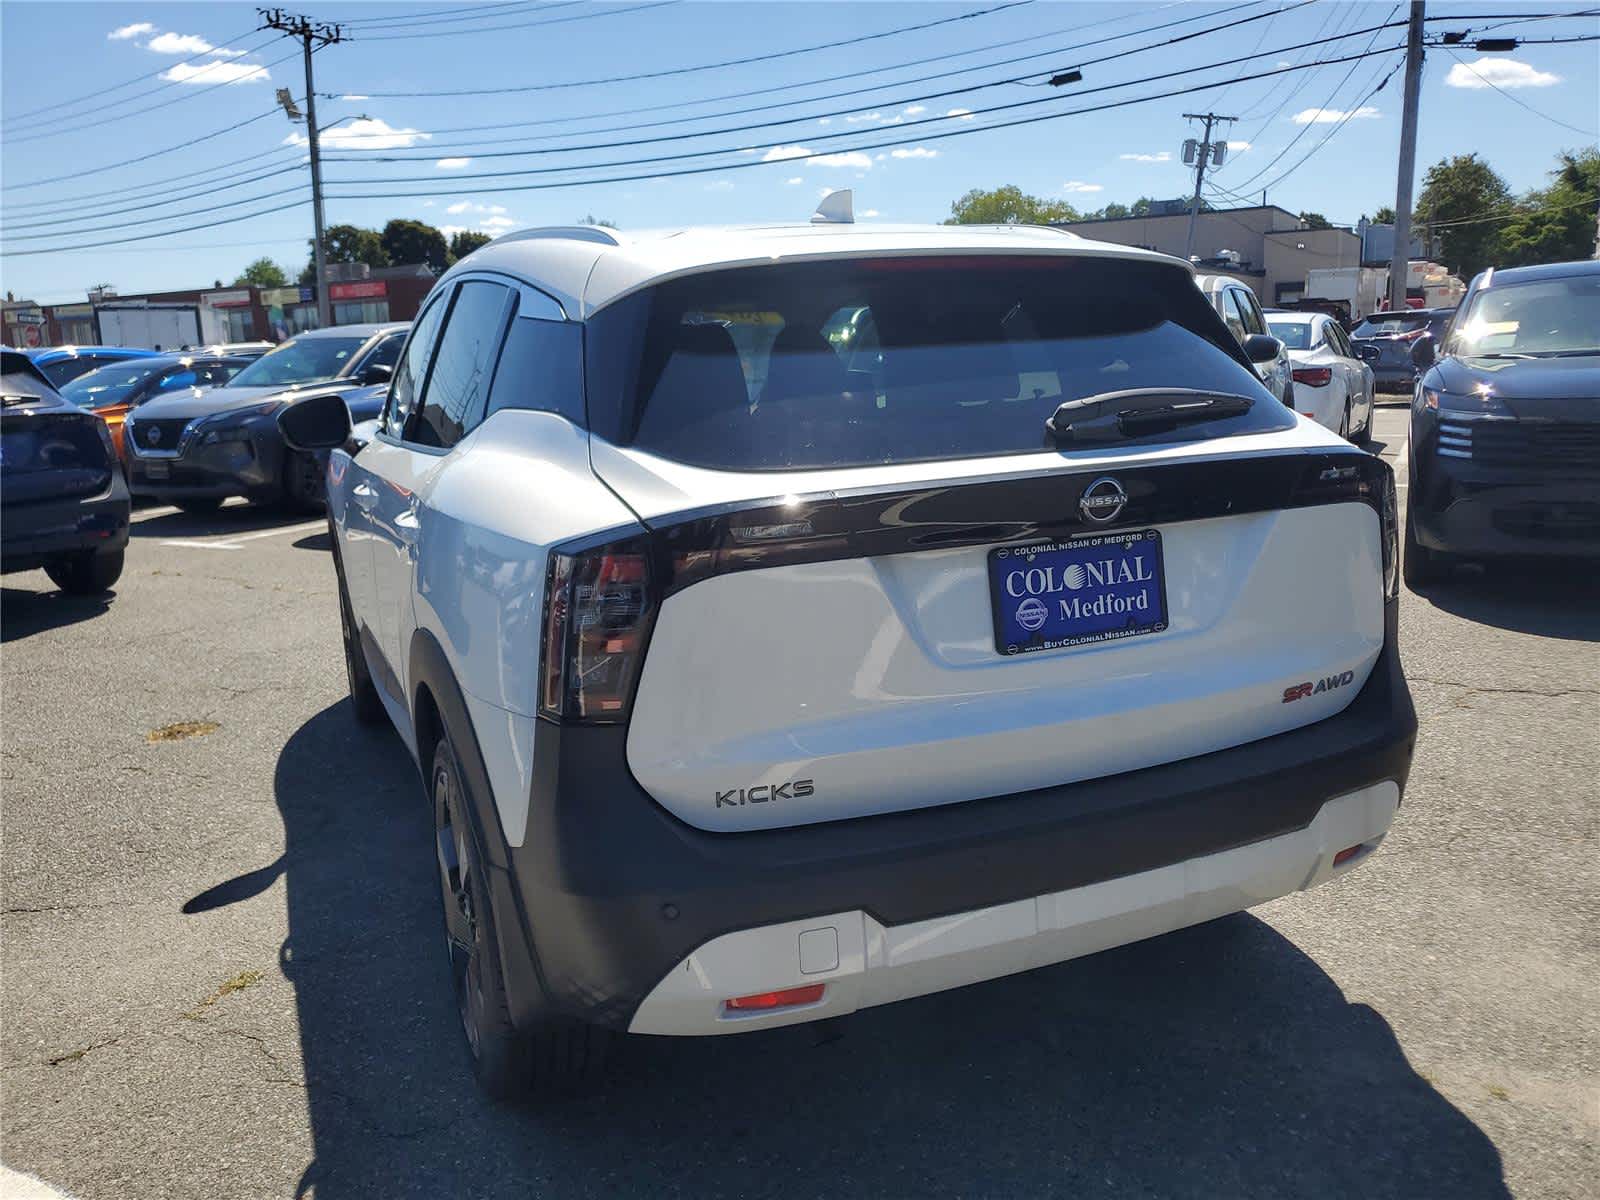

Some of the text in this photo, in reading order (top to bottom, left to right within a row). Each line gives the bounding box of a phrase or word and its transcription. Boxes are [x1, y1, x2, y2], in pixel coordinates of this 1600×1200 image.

[1080, 495, 1128, 506] NISSAN
[1014, 544, 1057, 556] COLONIAL
[1058, 540, 1090, 550] NISSAN
[1091, 538, 1103, 547] OF
[1104, 533, 1143, 545] MEDFORD
[1006, 556, 1152, 598] COLONIAL
[1018, 609, 1046, 618] NISSAN
[1059, 589, 1148, 620] Medford
[1282, 670, 1354, 704] SR AWD
[715, 779, 815, 809] KICKS
